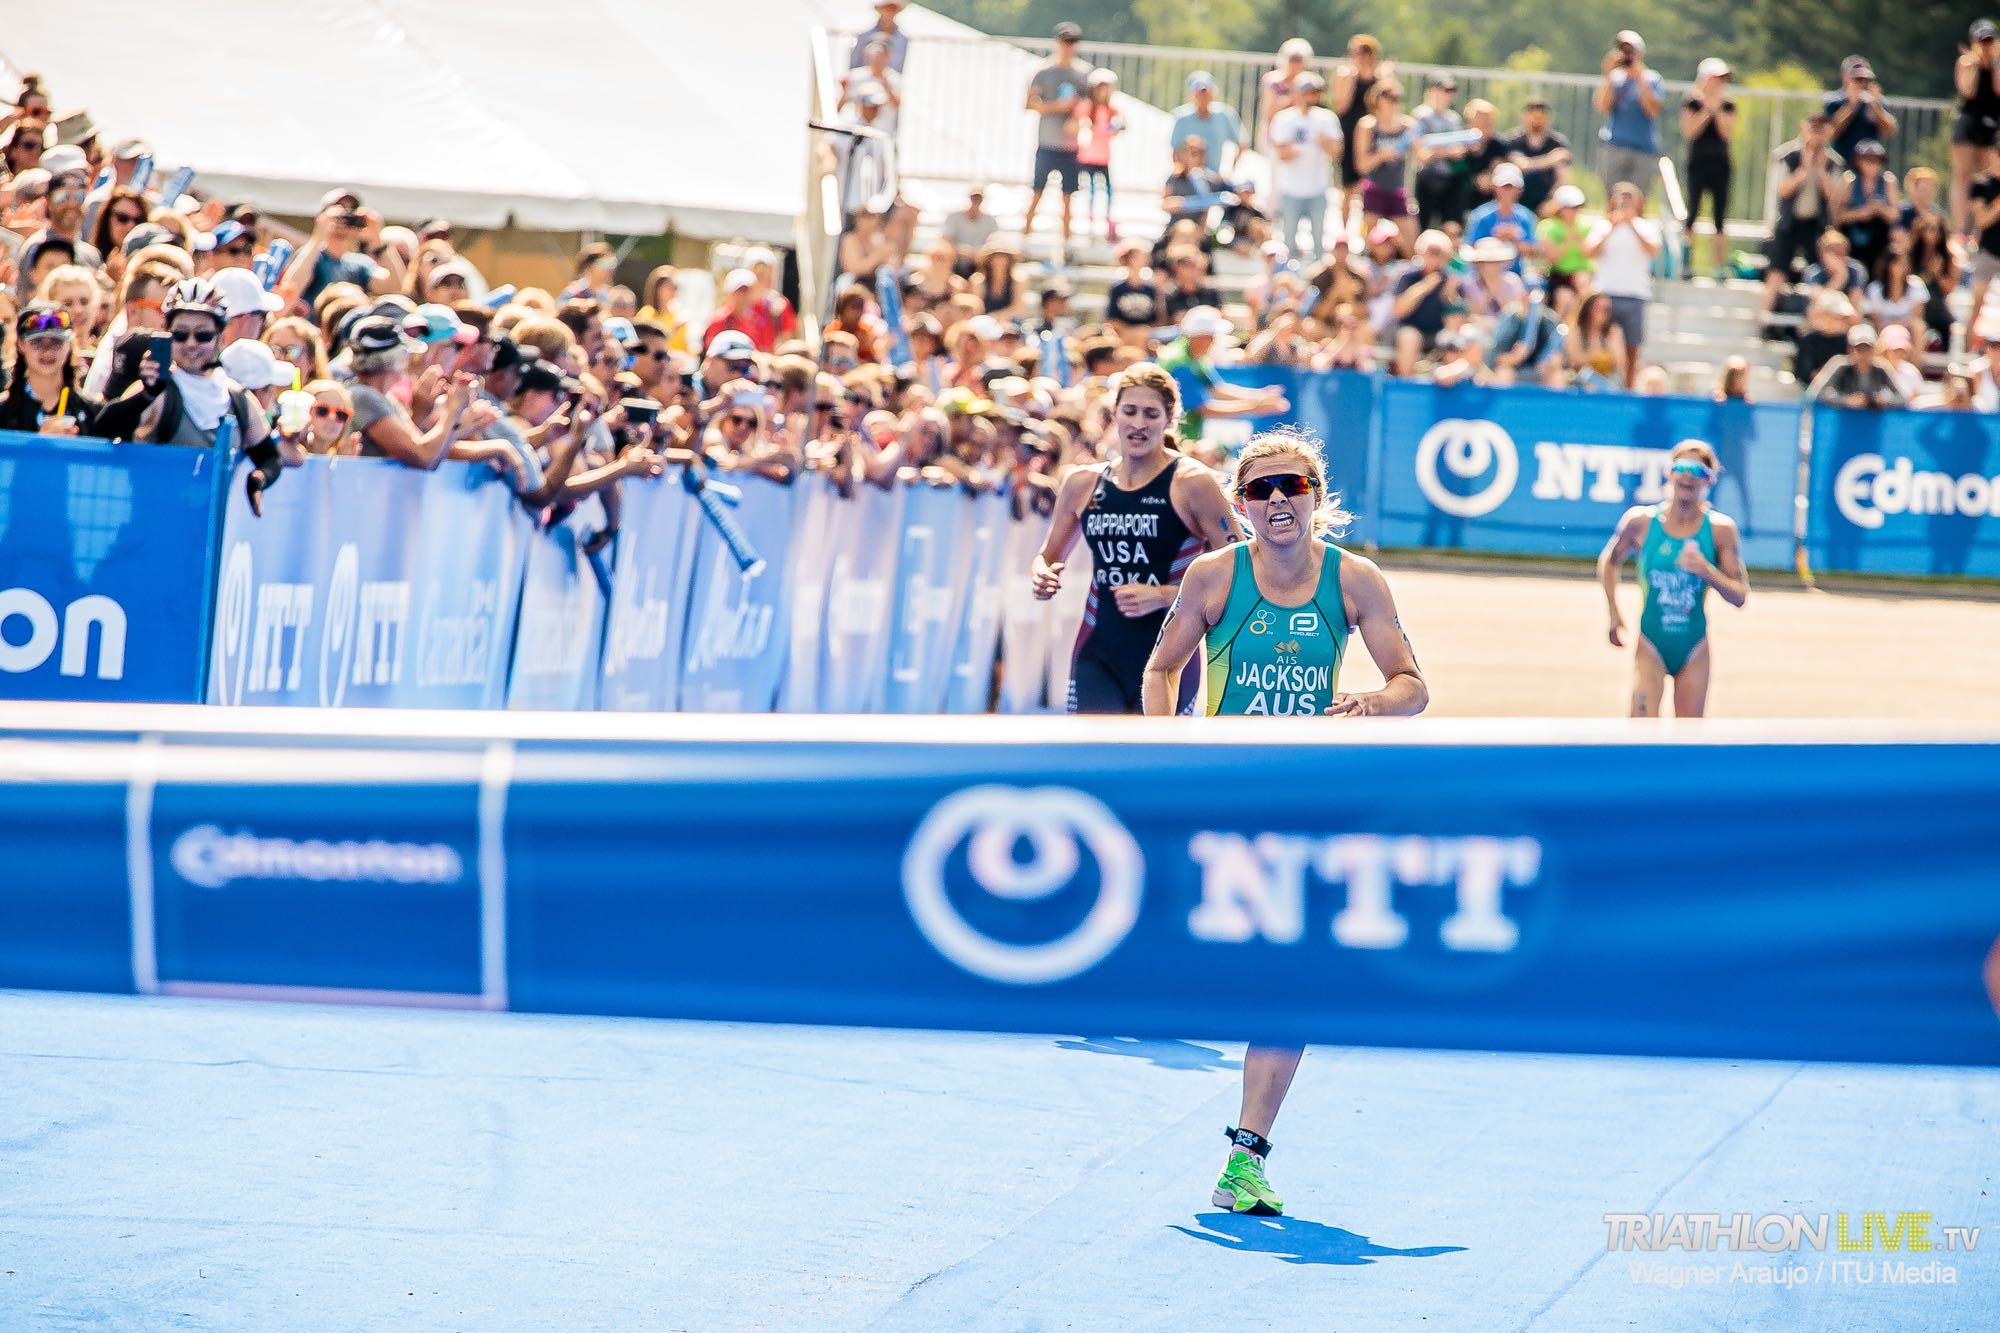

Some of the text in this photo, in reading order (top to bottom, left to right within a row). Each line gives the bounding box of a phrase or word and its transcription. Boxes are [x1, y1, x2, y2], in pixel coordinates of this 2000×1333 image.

[1532, 441, 1673, 504] NTT
[1086, 513, 1159, 537] RAPPAPORT
[1097, 541, 1149, 564] USA
[1276, 656, 1298, 665] AIS
[1236, 661, 1330, 692] JACKSON
[1244, 691, 1316, 718] AUS
[1187, 830, 1543, 953] NTT
